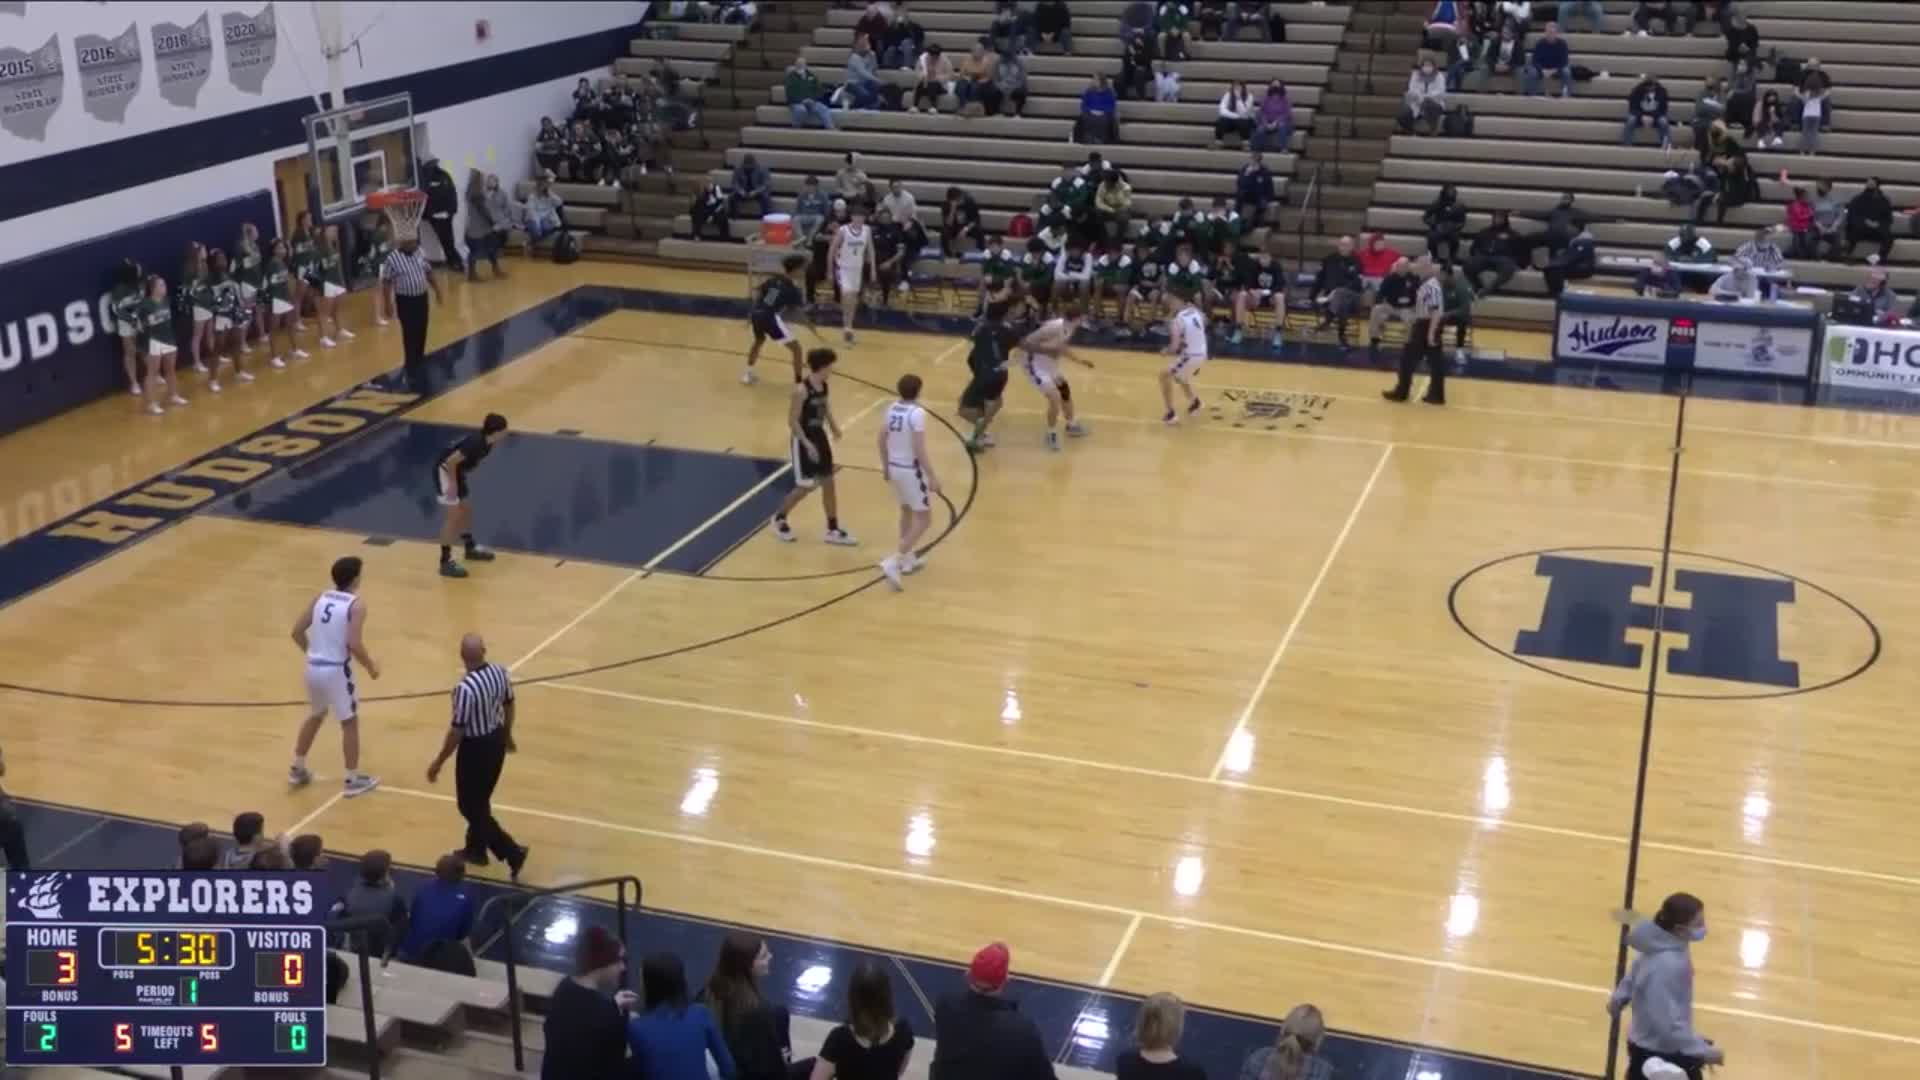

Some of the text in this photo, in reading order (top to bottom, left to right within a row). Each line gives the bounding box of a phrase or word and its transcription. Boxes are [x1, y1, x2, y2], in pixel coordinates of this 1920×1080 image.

[158, 34, 188, 50] 2018
[225, 24, 256, 40] 2020
[81, 46, 115, 63] 2016
[0, 59, 34, 78] 2015
[1568, 314, 1657, 352] Hudson
[46, 387, 421, 543] HUDSON
[320, 602, 335, 624] 5
[1513, 554, 1800, 688] H
